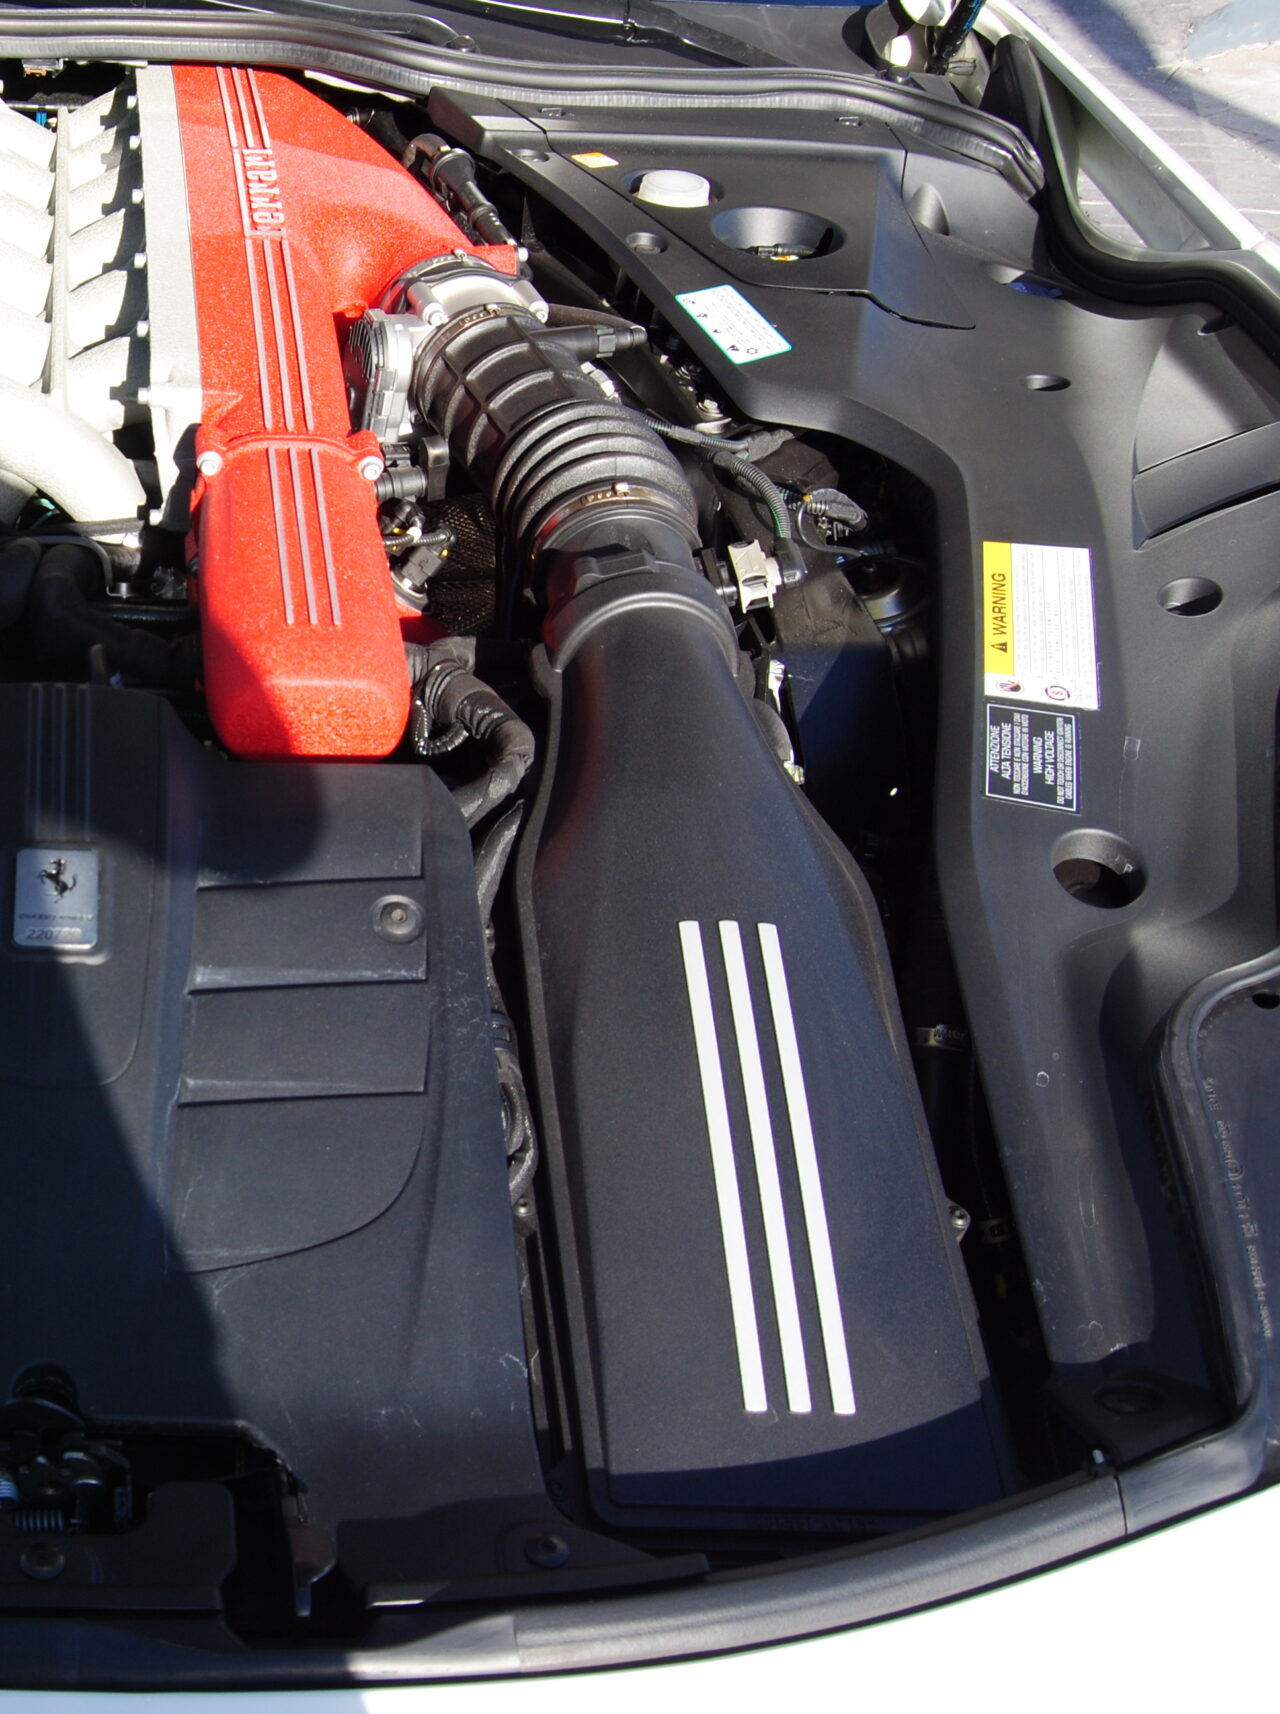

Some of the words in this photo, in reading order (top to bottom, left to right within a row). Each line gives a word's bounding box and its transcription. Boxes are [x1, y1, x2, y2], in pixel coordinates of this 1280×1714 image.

[232, 148, 287, 240] Ferrari
[991, 572, 1008, 636] WARNING
[990, 725, 1000, 773] ATTENZIONE
[1001, 722, 1011, 759] TENSIONE
[1033, 736, 1043, 774] WARNING
[1044, 730, 1054, 763] VOLTAGE
[1001, 761, 1011, 780] ALTA
[1044, 764, 1054, 785] HIGH
